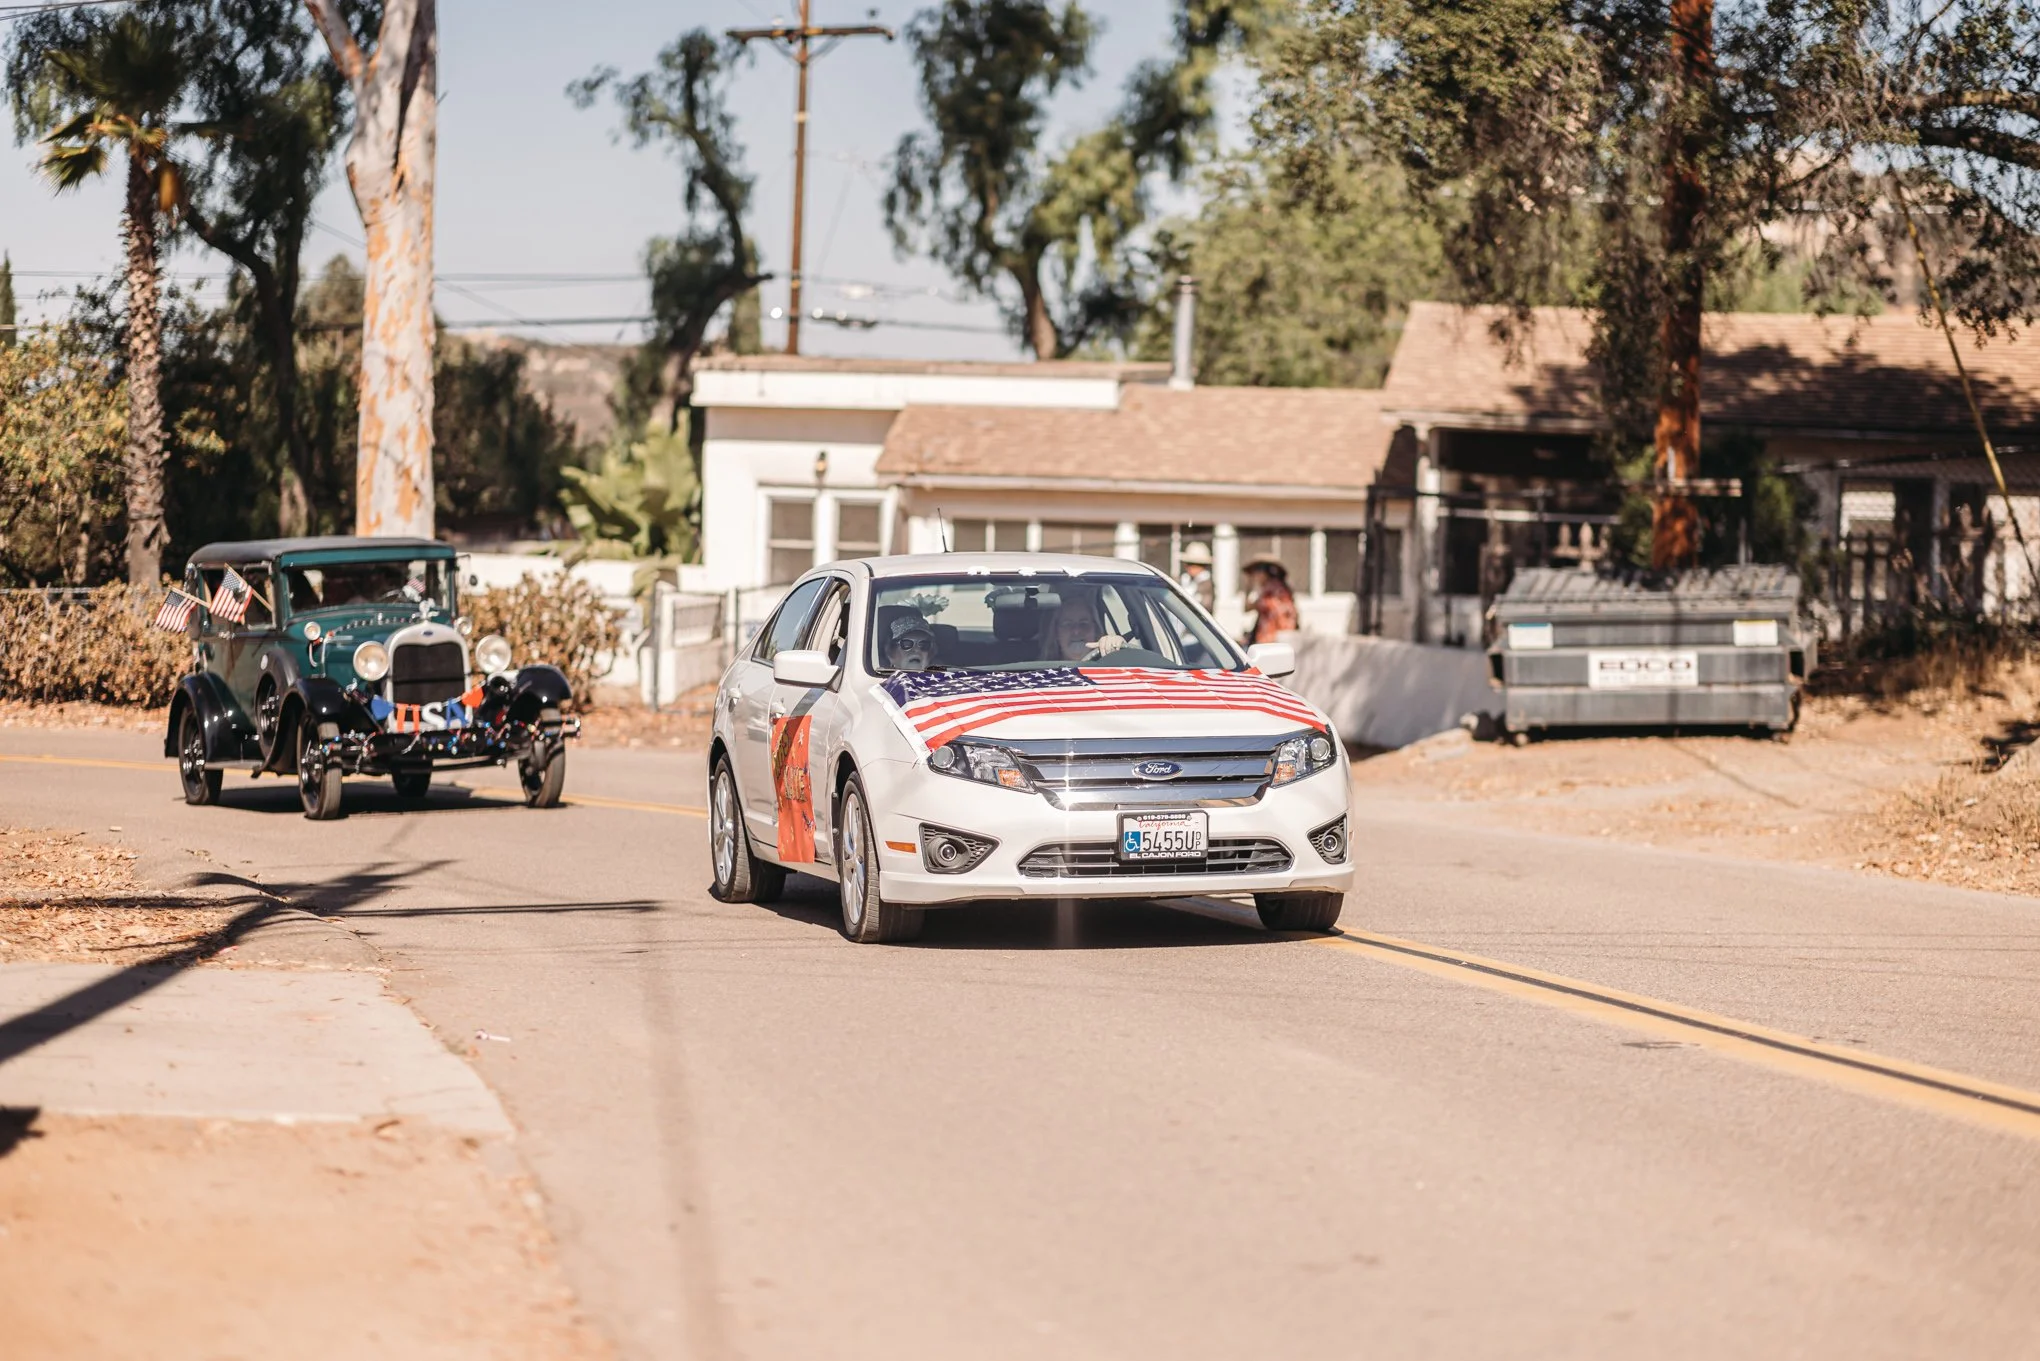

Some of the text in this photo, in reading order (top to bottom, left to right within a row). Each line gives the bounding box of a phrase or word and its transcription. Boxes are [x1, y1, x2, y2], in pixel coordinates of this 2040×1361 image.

[1599, 658, 1692, 673] EDCO
[395, 697, 469, 733] USA
[1145, 762, 1172, 774] Ford
[1138, 820, 1191, 830] California
[1141, 851, 1175, 859] CAJON
